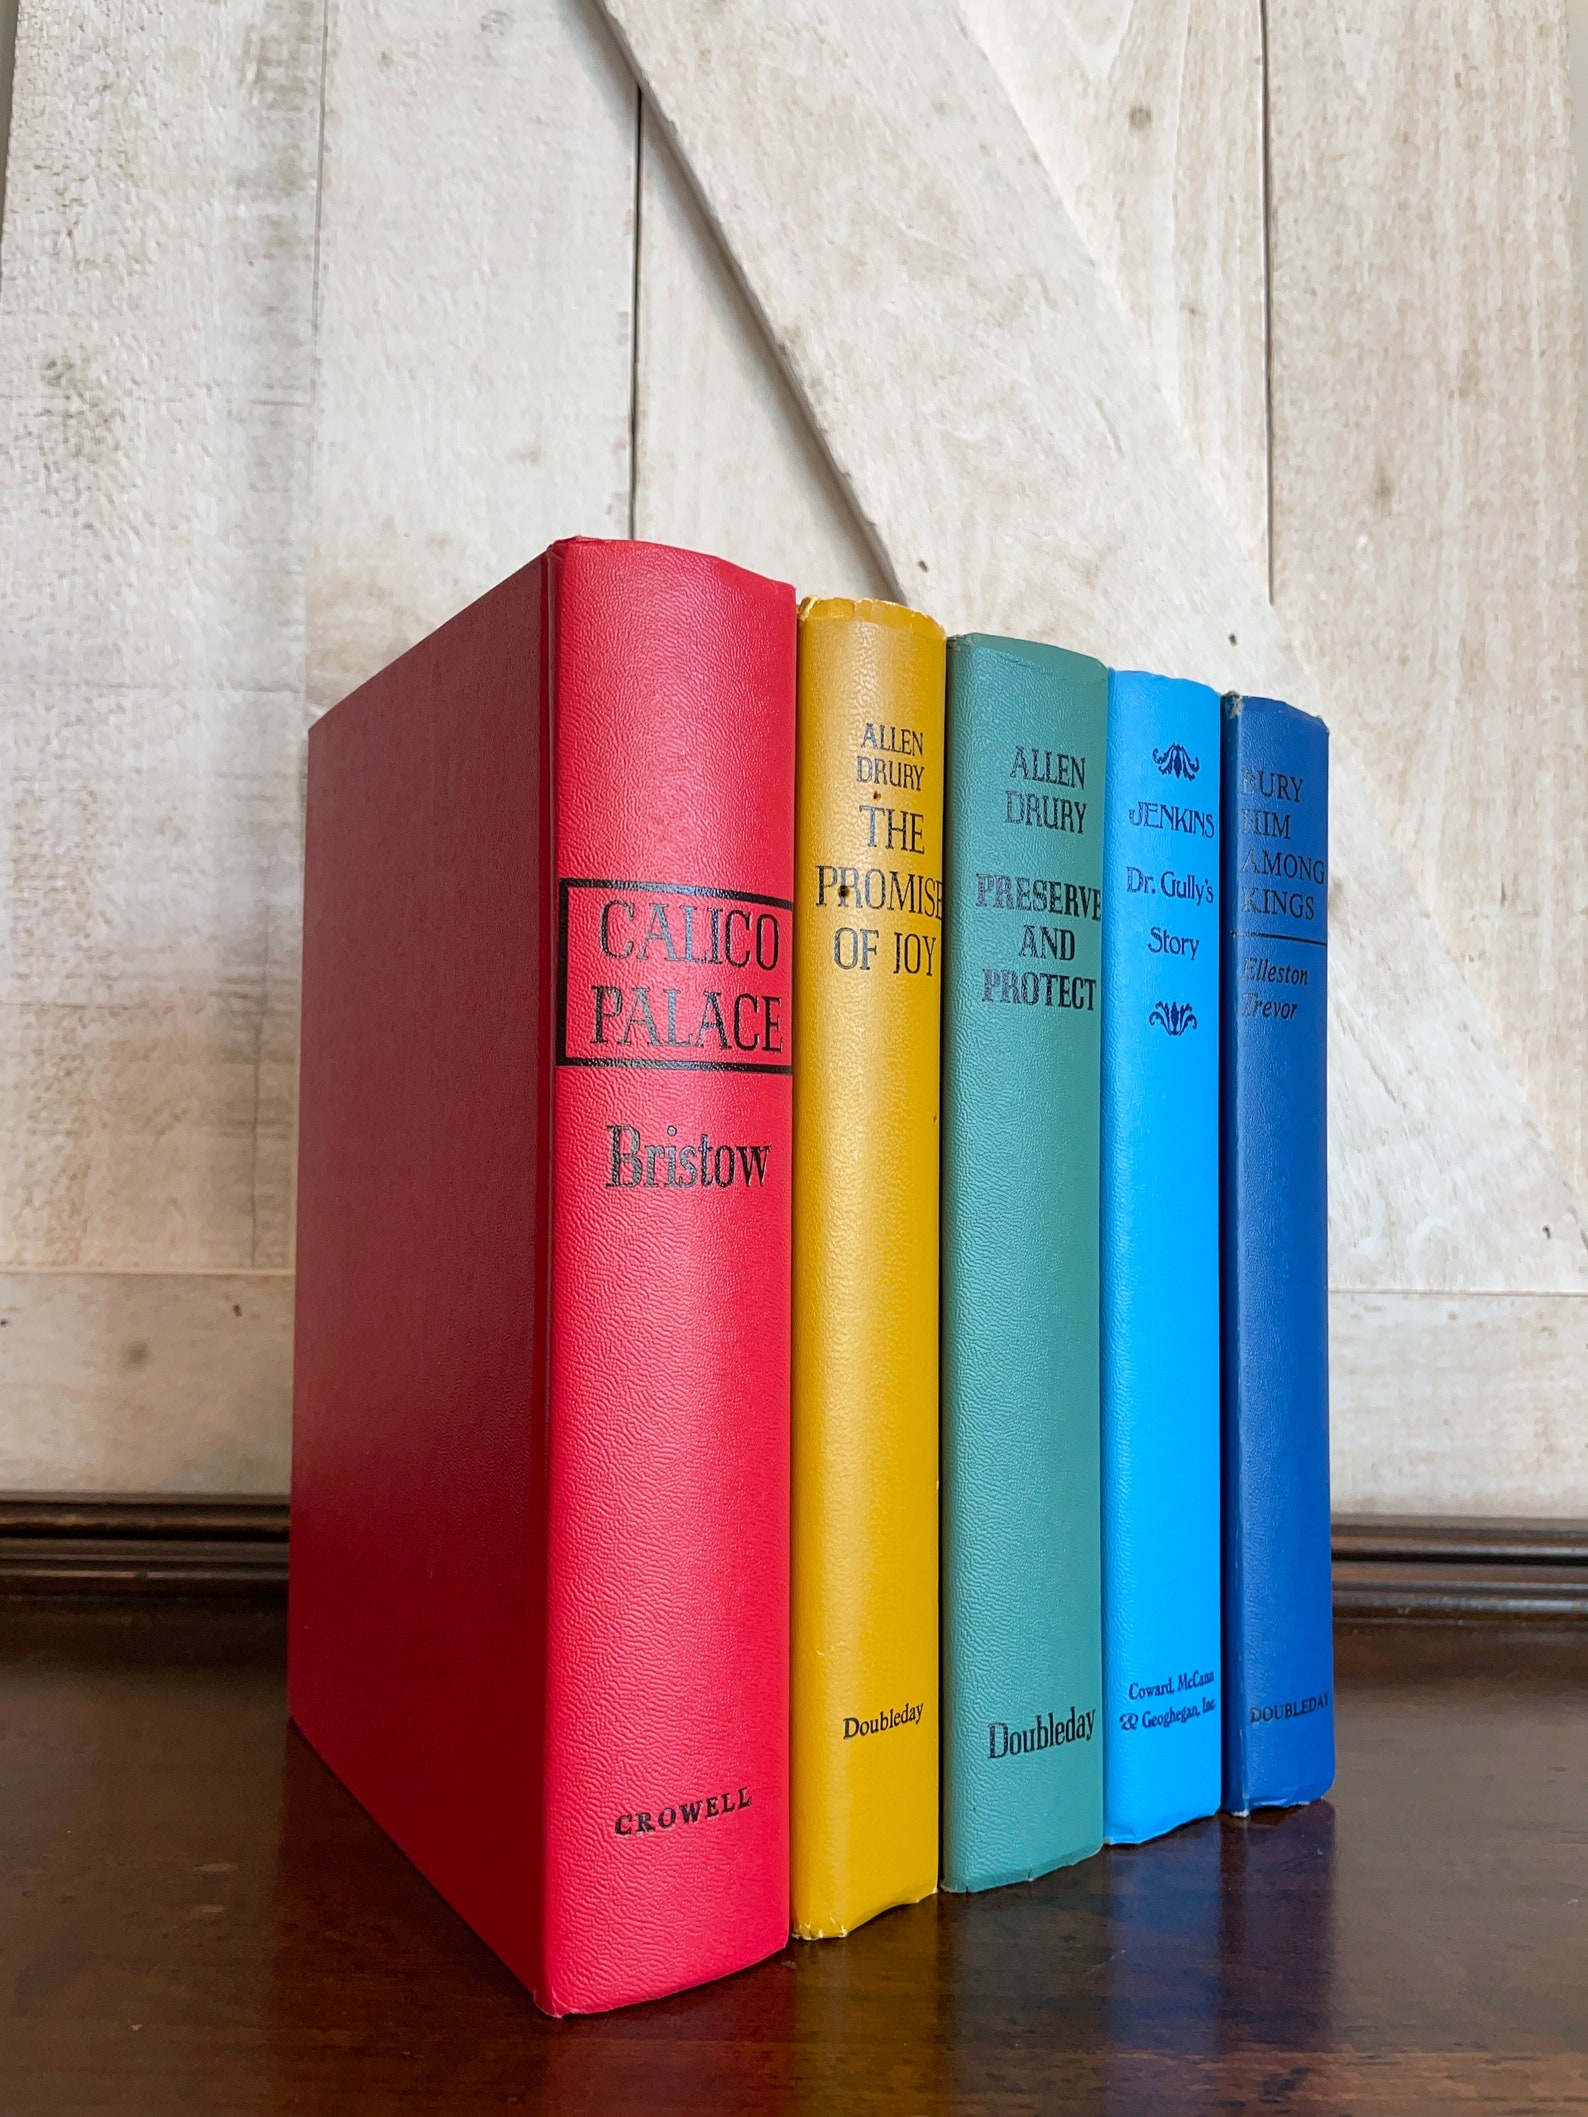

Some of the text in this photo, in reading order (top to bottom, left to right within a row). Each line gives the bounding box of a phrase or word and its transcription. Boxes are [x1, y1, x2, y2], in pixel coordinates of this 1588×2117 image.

[861, 723, 924, 757] ALLEN
[856, 755, 925, 791] DRURY
[1010, 745, 1086, 790] ALLEN
[1241, 767, 1304, 802] BURY
[859, 805, 925, 855] THE
[1005, 790, 1087, 834] DRURY
[1129, 801, 1215, 839] JENKINS
[1241, 808, 1291, 840] HIM
[1241, 848, 1325, 884] AMONG
[815, 865, 942, 920] PROMISE
[975, 872, 1101, 922] PRESERVE
[1126, 866, 1214, 906] Dr. Gully's
[1241, 887, 1314, 920] KINGS
[600, 899, 780, 970] CALICO
[834, 927, 937, 977] OF JOY
[1018, 924, 1076, 961] AND
[1147, 927, 1200, 960] Story
[981, 968, 1097, 1011] PROTECT
[1241, 957, 1309, 985] Elleston
[590, 985, 783, 1053] PALACE
[1241, 992, 1299, 1019] Trevor
[605, 1125, 772, 1188] Bristow
[1178, 1669, 1215, 1692] McCann
[842, 1703, 925, 1740] Doubleday
[1119, 1712, 1138, 1731] &
[1250, 1690, 1330, 1723] DOUBLEDAY
[988, 1706, 1097, 1759] Doubleday
[614, 1786, 754, 1836] CROWELL
